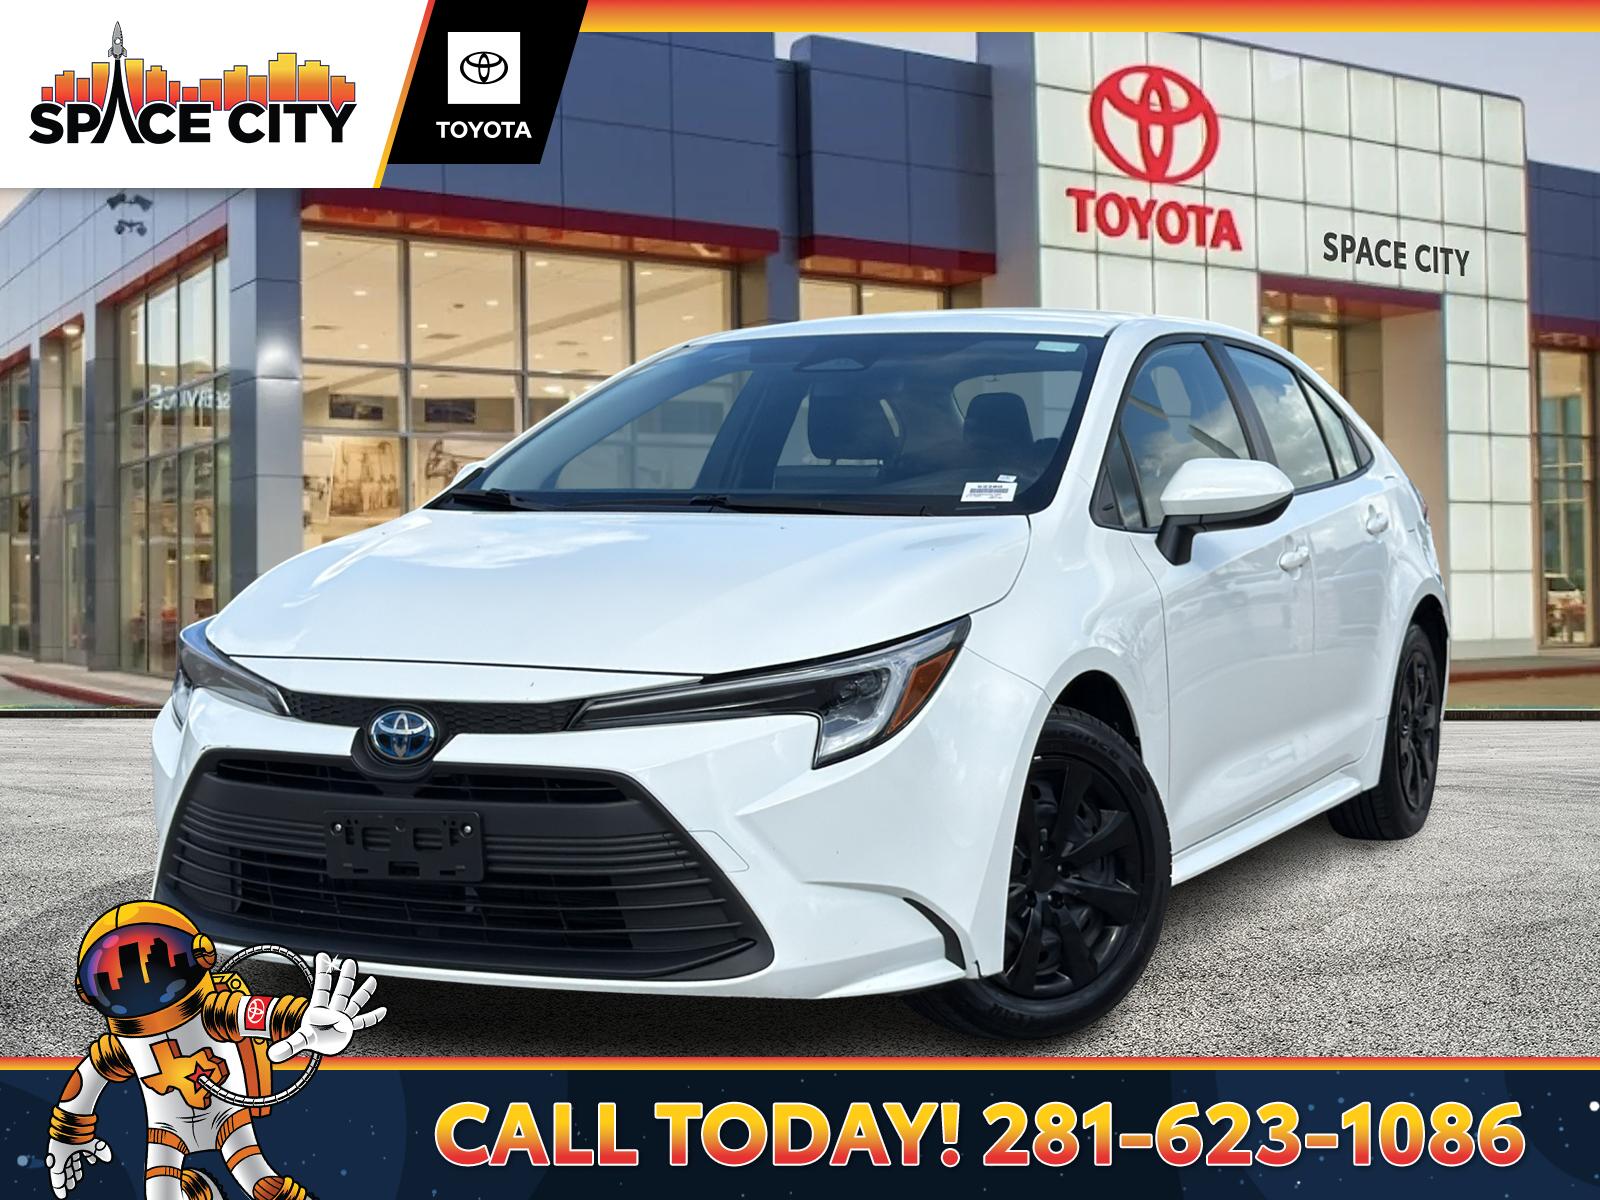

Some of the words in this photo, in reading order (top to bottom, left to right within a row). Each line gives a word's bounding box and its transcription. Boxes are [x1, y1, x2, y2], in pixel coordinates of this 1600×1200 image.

[1065, 188, 1242, 251] TOYOTA
[1323, 232, 1407, 270] SPACE
[1414, 244, 1470, 277] CITY
